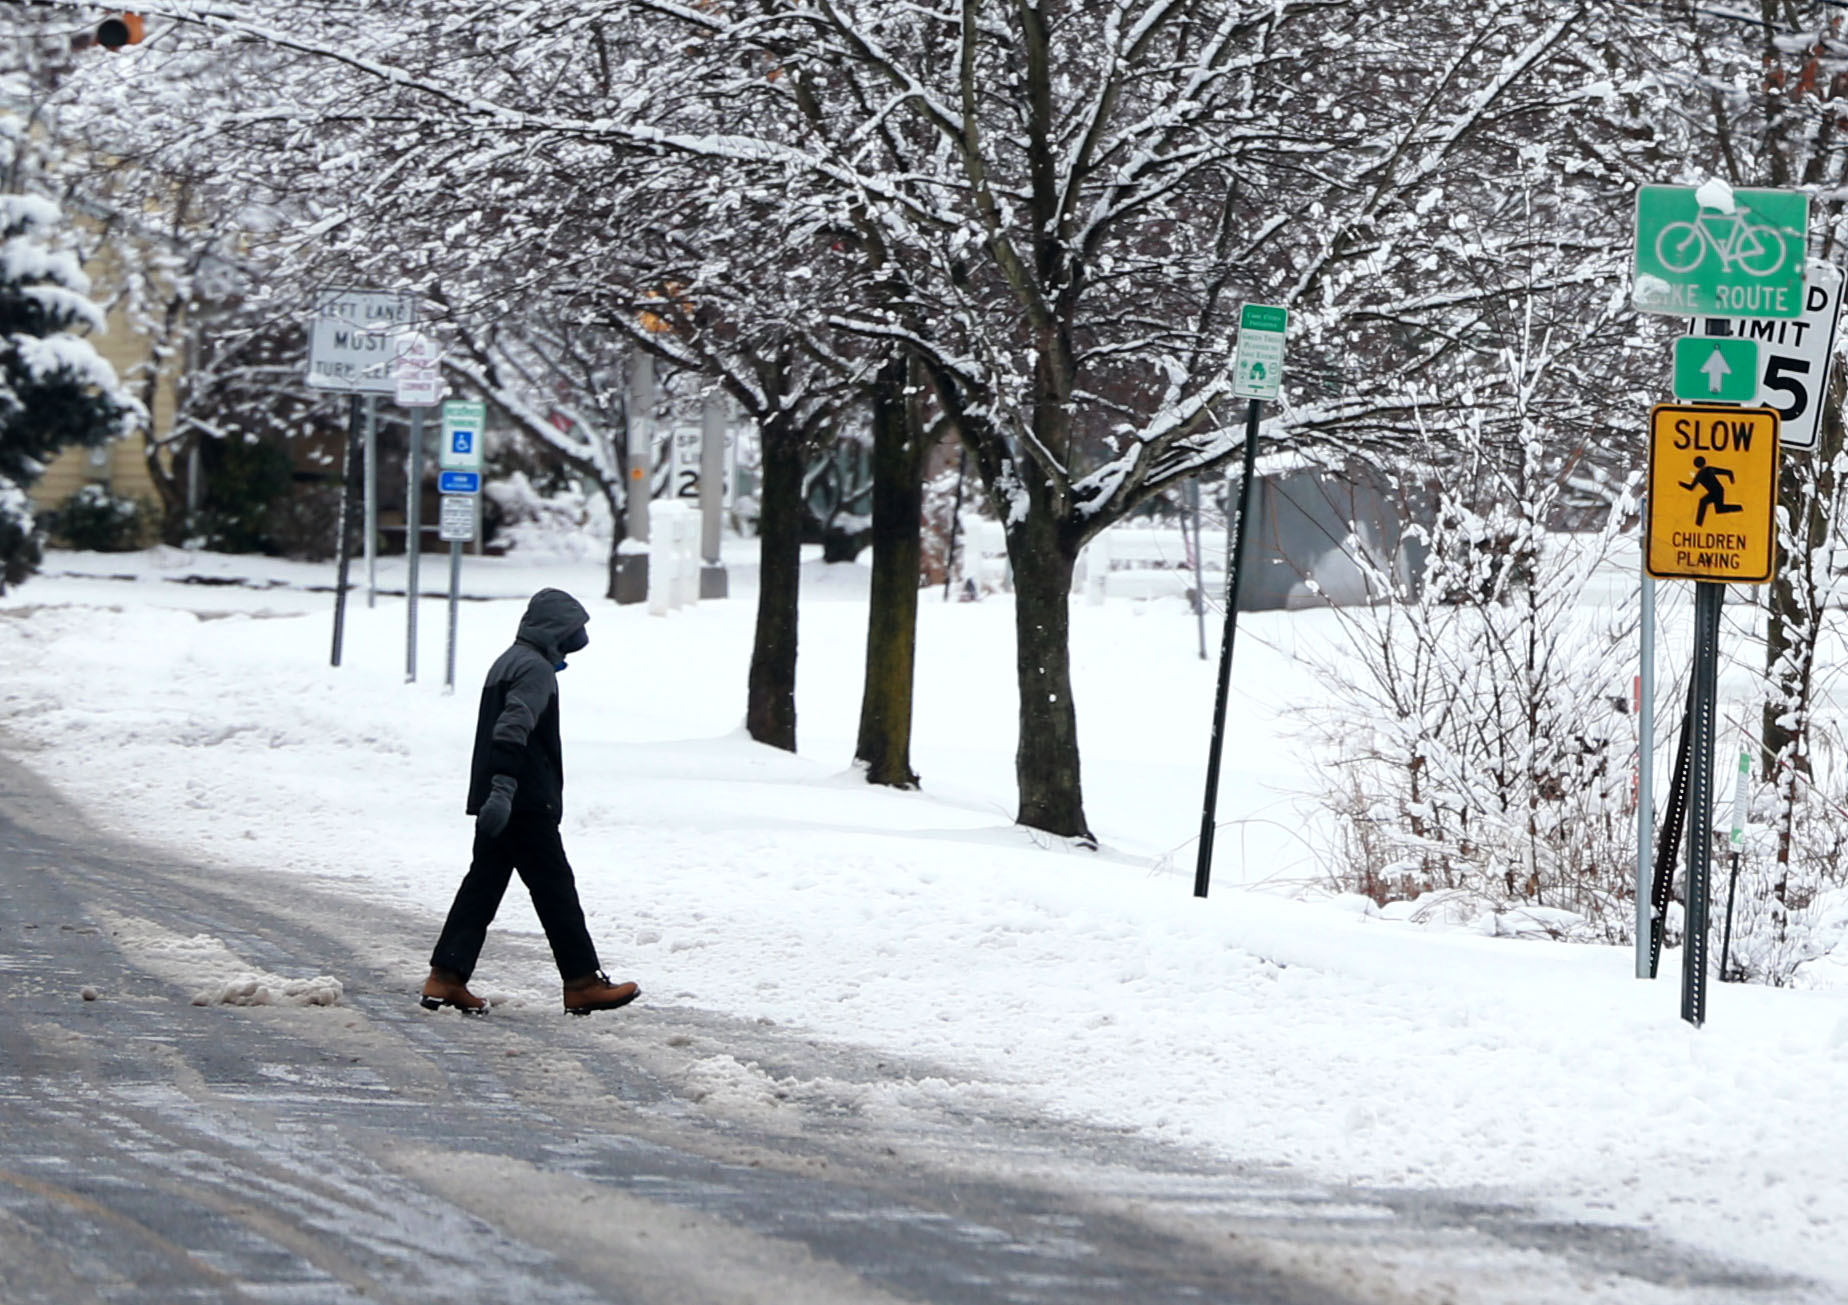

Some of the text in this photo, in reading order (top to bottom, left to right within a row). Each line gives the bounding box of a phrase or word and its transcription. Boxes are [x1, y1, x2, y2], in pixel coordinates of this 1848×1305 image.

[1716, 284, 1789, 311] ROUTE
[320, 302, 405, 321] LEFT LANE
[334, 330, 387, 351] MUST
[1729, 319, 1811, 347] IMIT
[1673, 419, 1754, 452] SLOW
[1672, 531, 1747, 550] CHILDREN
[1677, 550, 1740, 570] PLAYING
